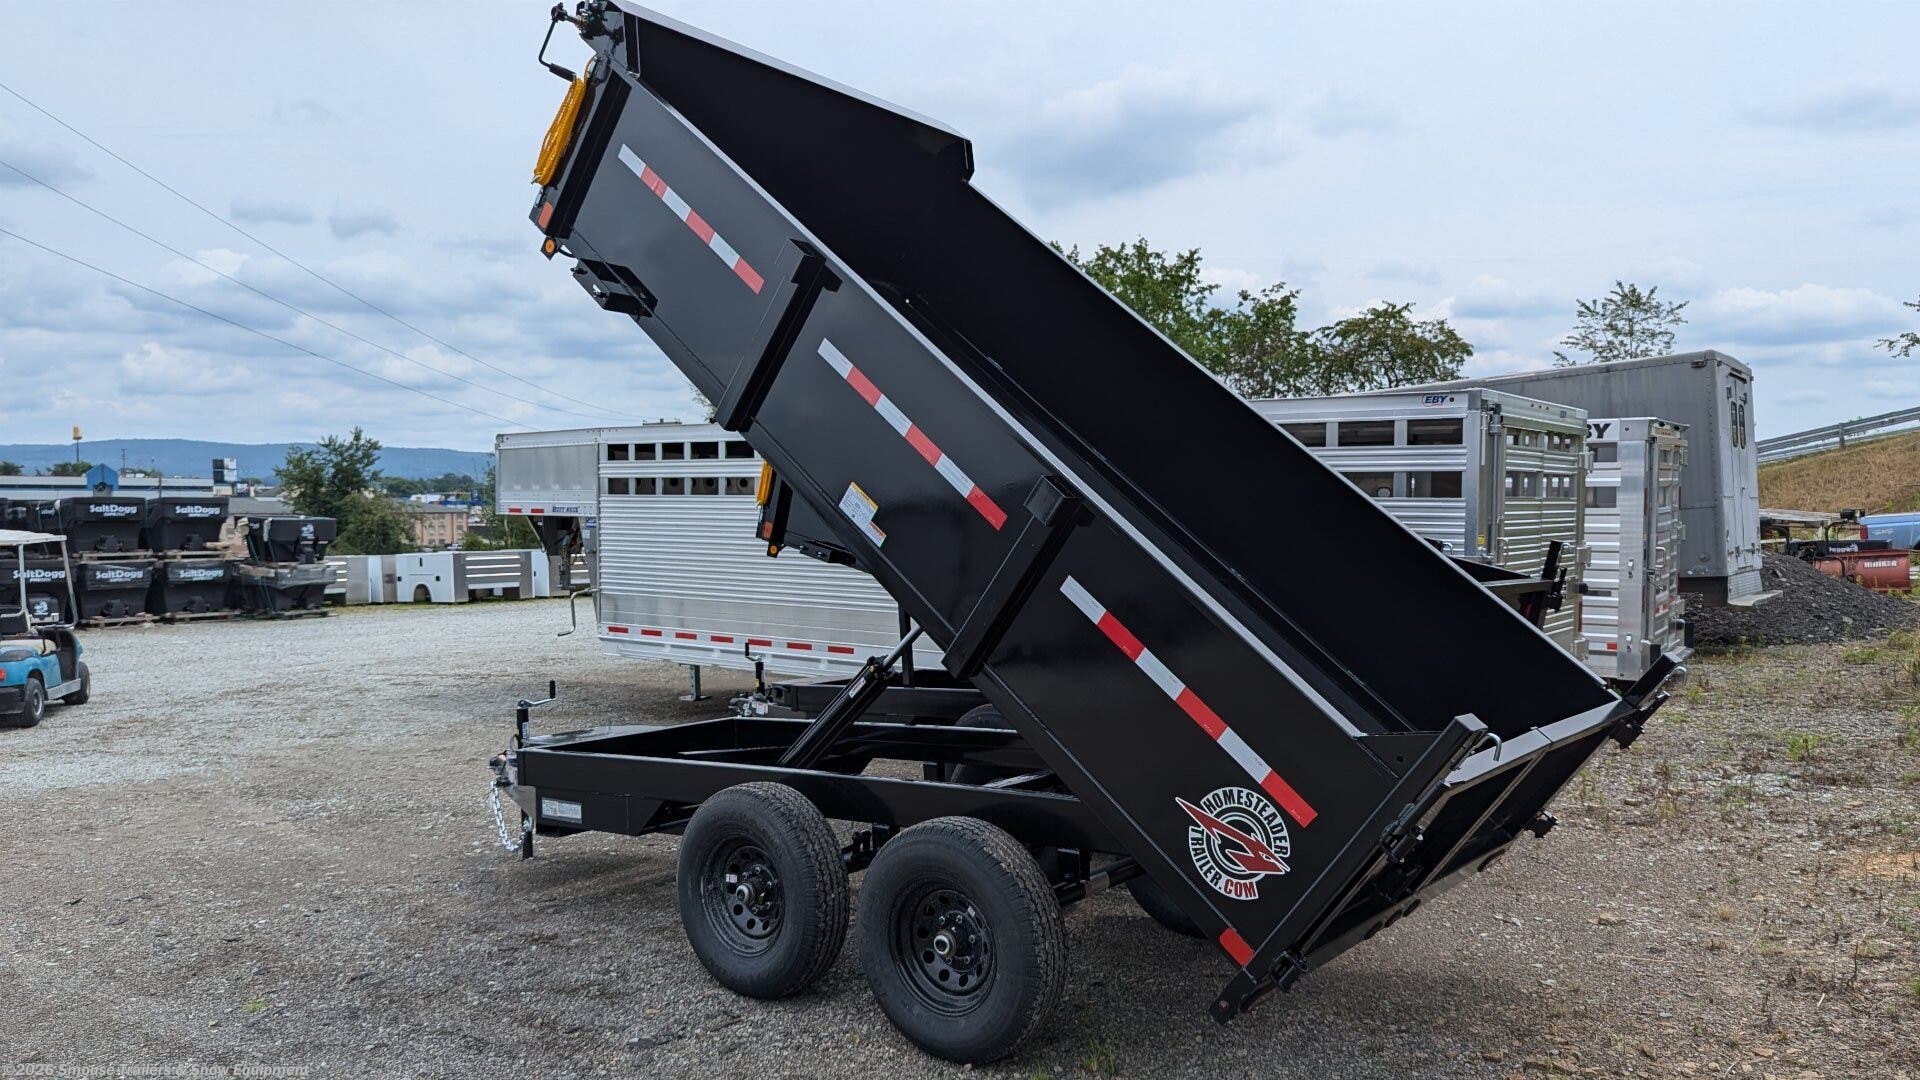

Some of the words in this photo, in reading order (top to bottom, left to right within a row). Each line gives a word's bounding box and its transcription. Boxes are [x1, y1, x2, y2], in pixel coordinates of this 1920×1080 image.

[1425, 395, 1448, 404] EBY
[89, 504, 138, 514] SaltDogg
[175, 505, 221, 515] SaltDogg
[96, 569, 144, 579] SaltDogg
[180, 568, 224, 578] SaltDogg
[1203, 788, 1288, 857] HOMESTEADER
[1190, 827, 1257, 898] TRAILER.COM
